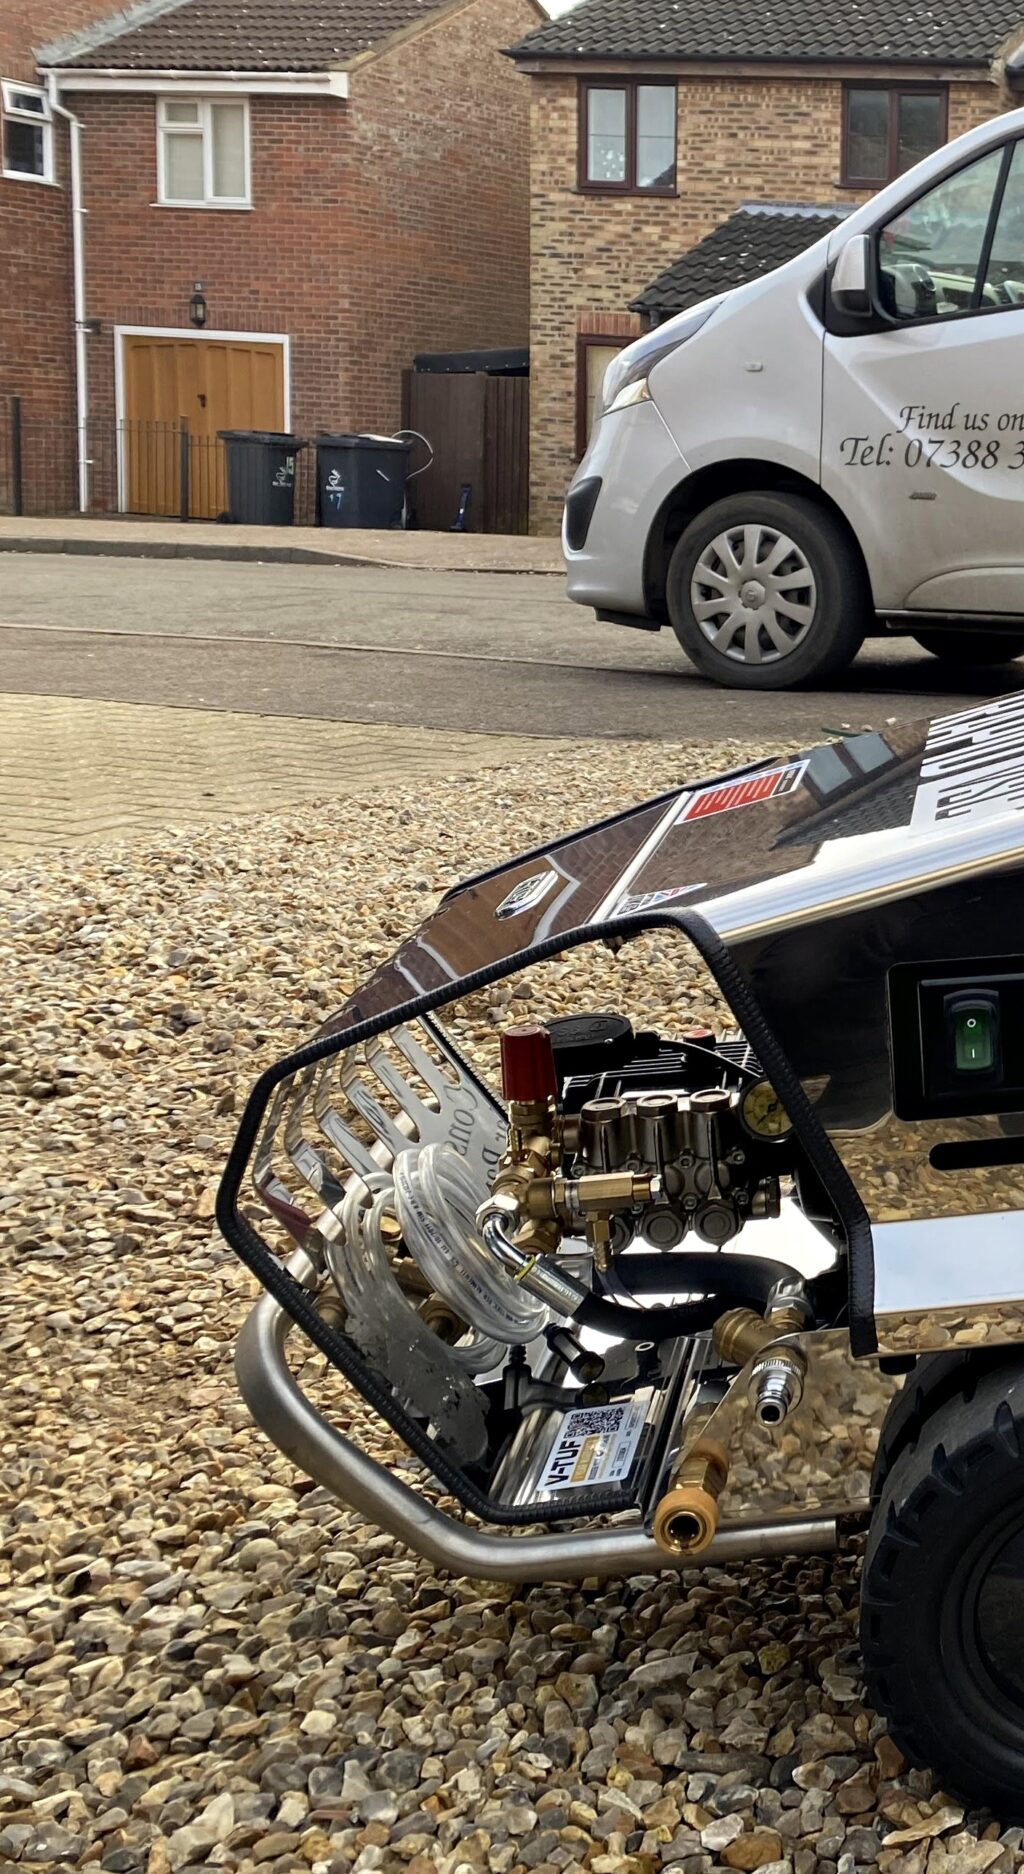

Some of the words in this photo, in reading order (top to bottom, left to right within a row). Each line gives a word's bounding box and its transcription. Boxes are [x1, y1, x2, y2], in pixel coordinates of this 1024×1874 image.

[896, 403, 960, 433] Find
[964, 411, 989, 432] us
[840, 433, 892, 467] Tel:
[904, 438, 1001, 470] 07388
[544, 1440, 581, 1486] V-TUF
